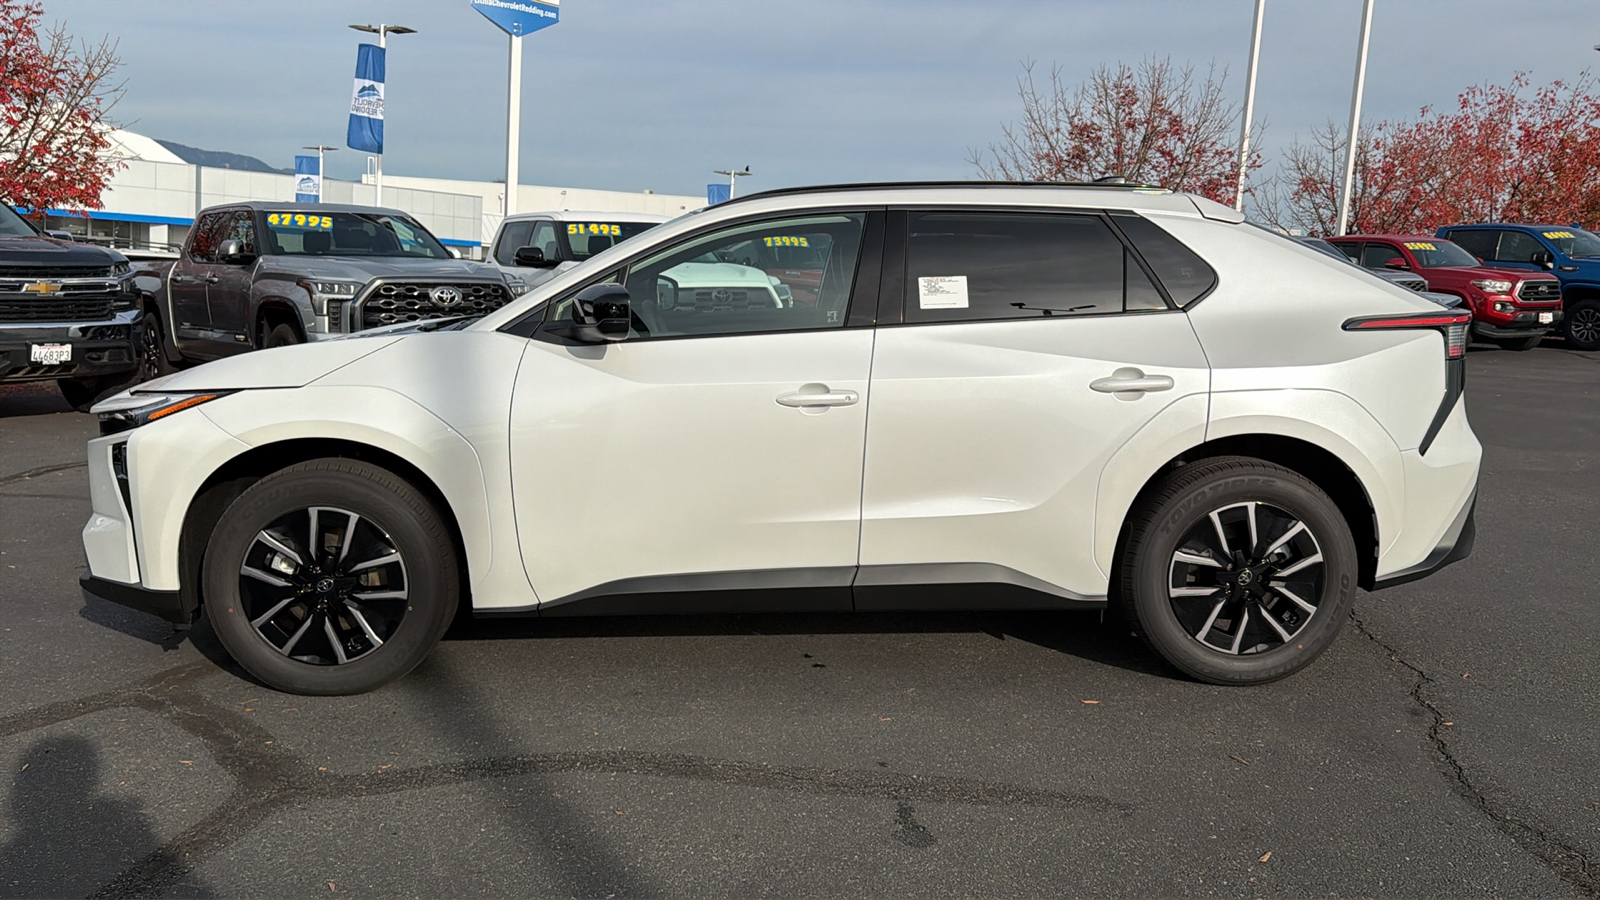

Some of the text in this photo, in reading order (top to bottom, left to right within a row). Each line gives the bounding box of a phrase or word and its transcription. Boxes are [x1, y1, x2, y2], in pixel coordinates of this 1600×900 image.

[267, 213, 333, 229] 47995
[763, 236, 809, 248] 73995
[1161, 478, 1277, 535] TOYO TIRES
